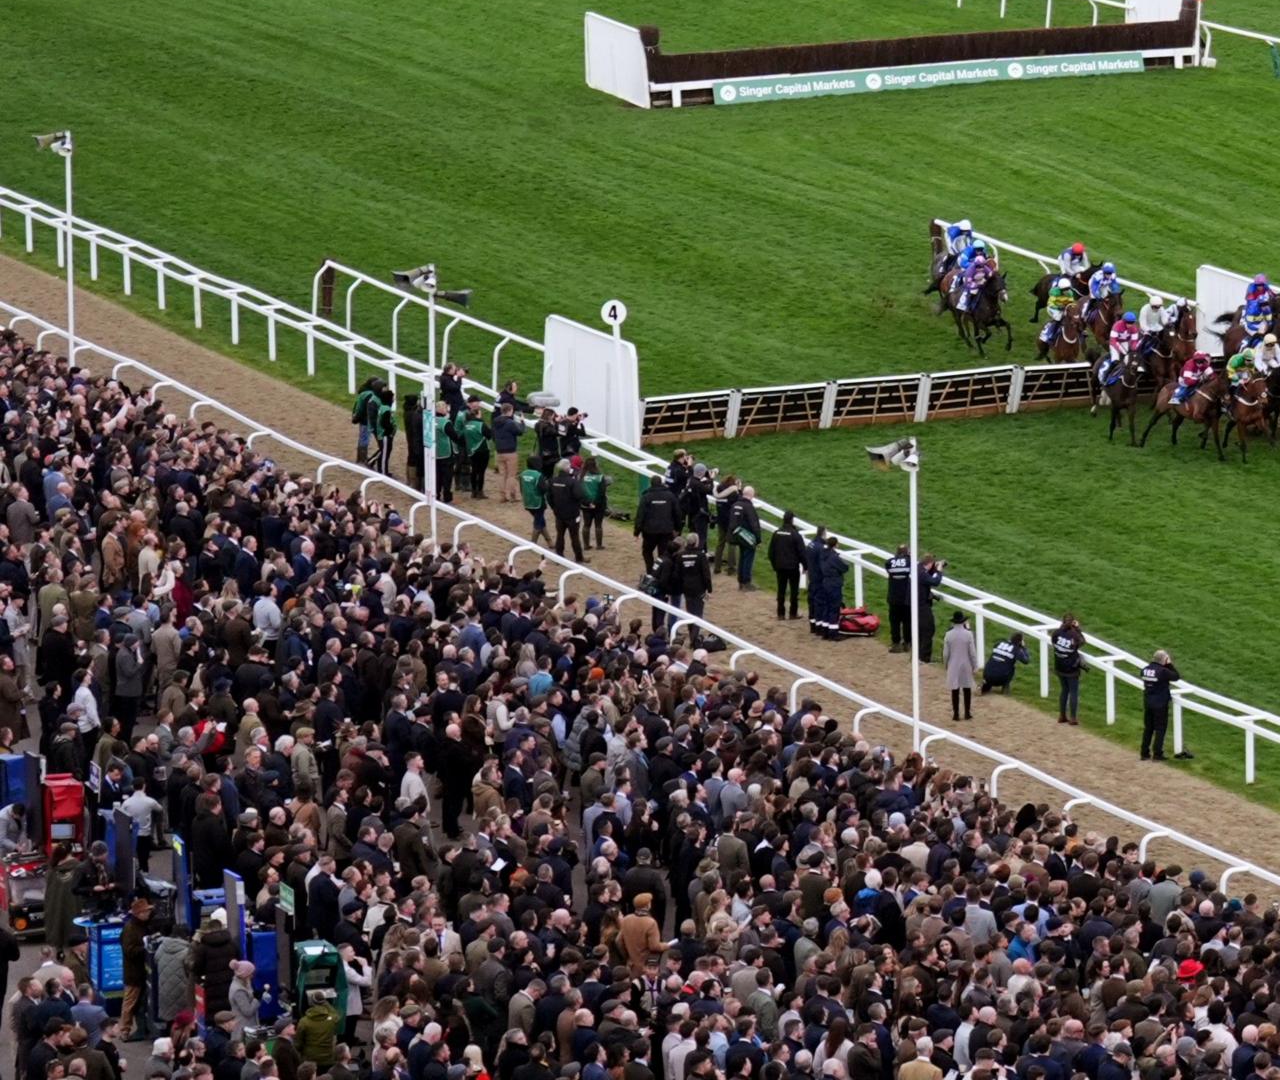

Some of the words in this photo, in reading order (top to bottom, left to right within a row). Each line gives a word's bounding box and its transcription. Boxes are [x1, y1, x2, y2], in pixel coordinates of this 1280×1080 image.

[1026, 64, 1058, 76] Singer
[1061, 61, 1096, 73] Capital
[1098, 58, 1140, 71] Markets
[884, 74, 916, 86] Singer
[919, 71, 955, 83] Capital
[957, 67, 999, 80] Markets
[739, 86, 773, 99] Singer
[775, 83, 811, 96] Capital
[813, 79, 856, 91] Markets
[608, 304, 618, 321] 4
[890, 558, 906, 568] 245
